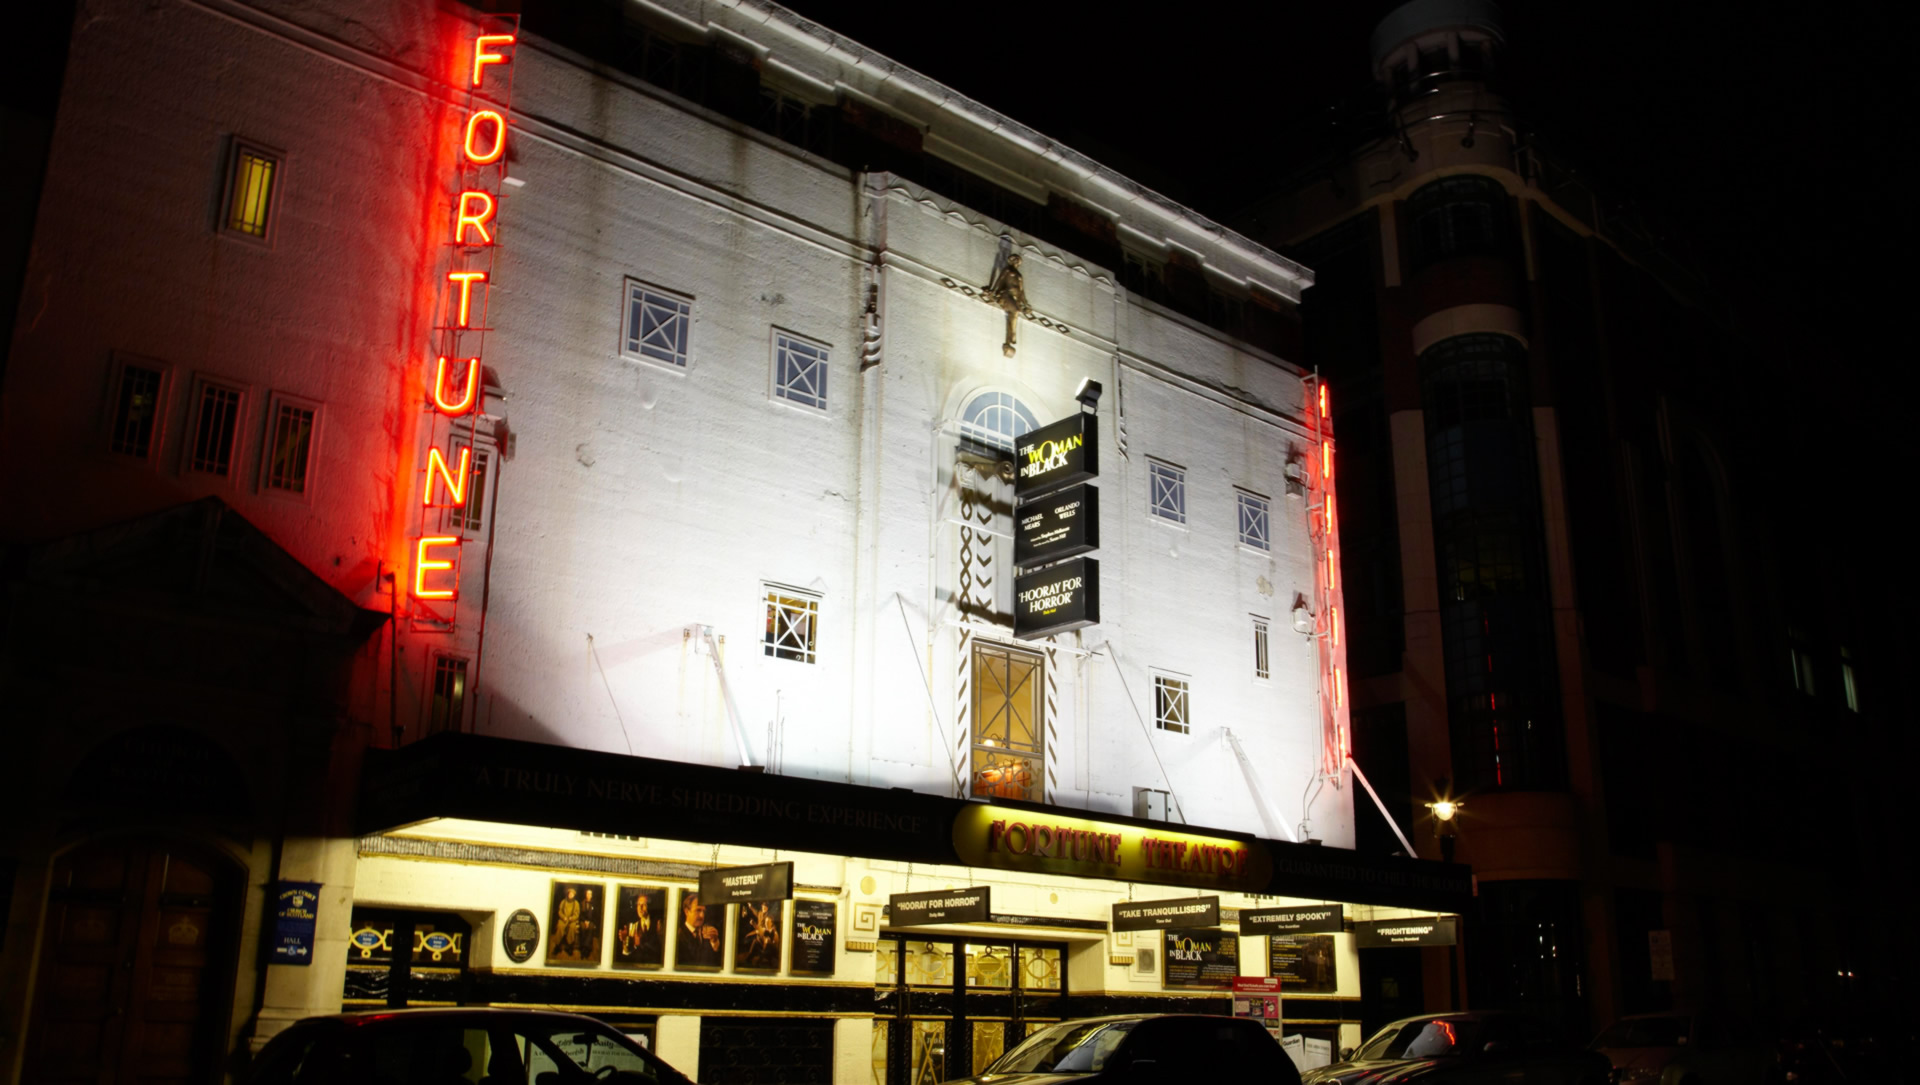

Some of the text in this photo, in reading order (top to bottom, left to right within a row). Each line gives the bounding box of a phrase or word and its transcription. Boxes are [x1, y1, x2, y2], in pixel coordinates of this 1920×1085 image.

[415, 35, 516, 600] FORTUNE
[1019, 444, 1034, 456] THE
[1028, 433, 1082, 464] WOMAN
[1020, 451, 1068, 478] IN BLACK
[1054, 501, 1080, 514] ORLANDO
[1021, 513, 1043, 525] MICHAEL
[1058, 510, 1076, 519] WELLS
[1062, 577, 1082, 592] FOR
[501, 767, 579, 796] TRULY
[587, 778, 800, 821] NERVE-SHREDDING
[991, 819, 1249, 877] FORTUNE THEATRE
[722, 874, 763, 887] "MASTERLY"
[897, 896, 980, 911] "HOORAY FOR HORROR"
[1119, 909, 1141, 918] "TAKE
[1249, 912, 1331, 924] "EXTREMELY SPOOKY"
[802, 925, 832, 936] WOMAN
[1377, 926, 1433, 936] "FRIGHTENING"
[284, 936, 301, 944] HALL
[802, 933, 824, 941] BLACK
[1168, 934, 1179, 942] THE
[1175, 937, 1212, 953] WOMAN
[1176, 950, 1202, 961] BLACK
